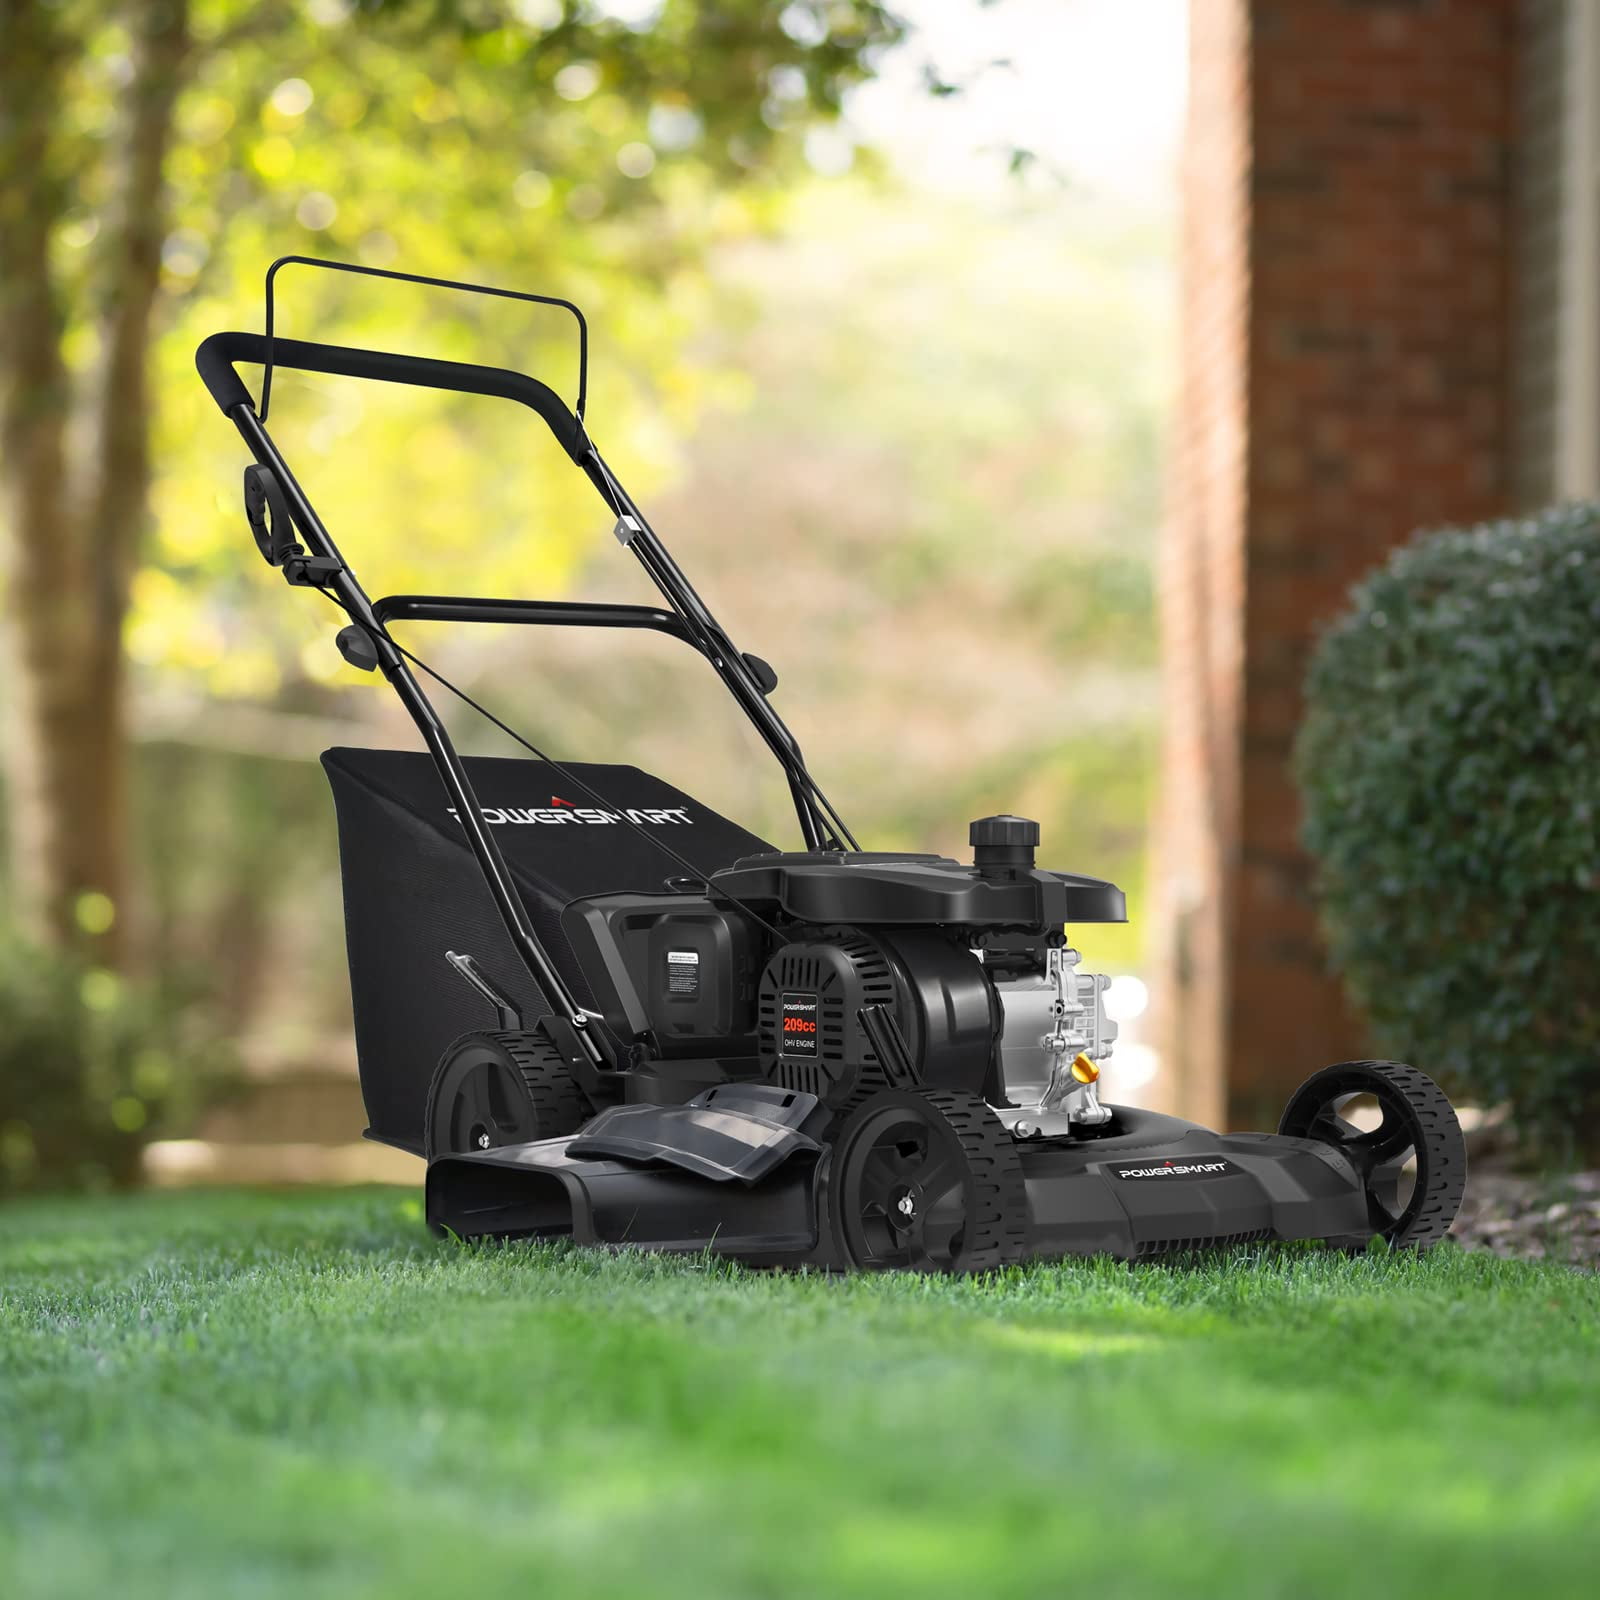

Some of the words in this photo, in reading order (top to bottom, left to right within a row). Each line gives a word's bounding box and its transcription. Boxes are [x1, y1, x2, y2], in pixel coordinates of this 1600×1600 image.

[784, 1017, 816, 1032] 209cc
[784, 1039, 795, 1047] OHV
[796, 1040, 815, 1048] ENGINE
[1119, 1163, 1225, 1178] POWERSMART
